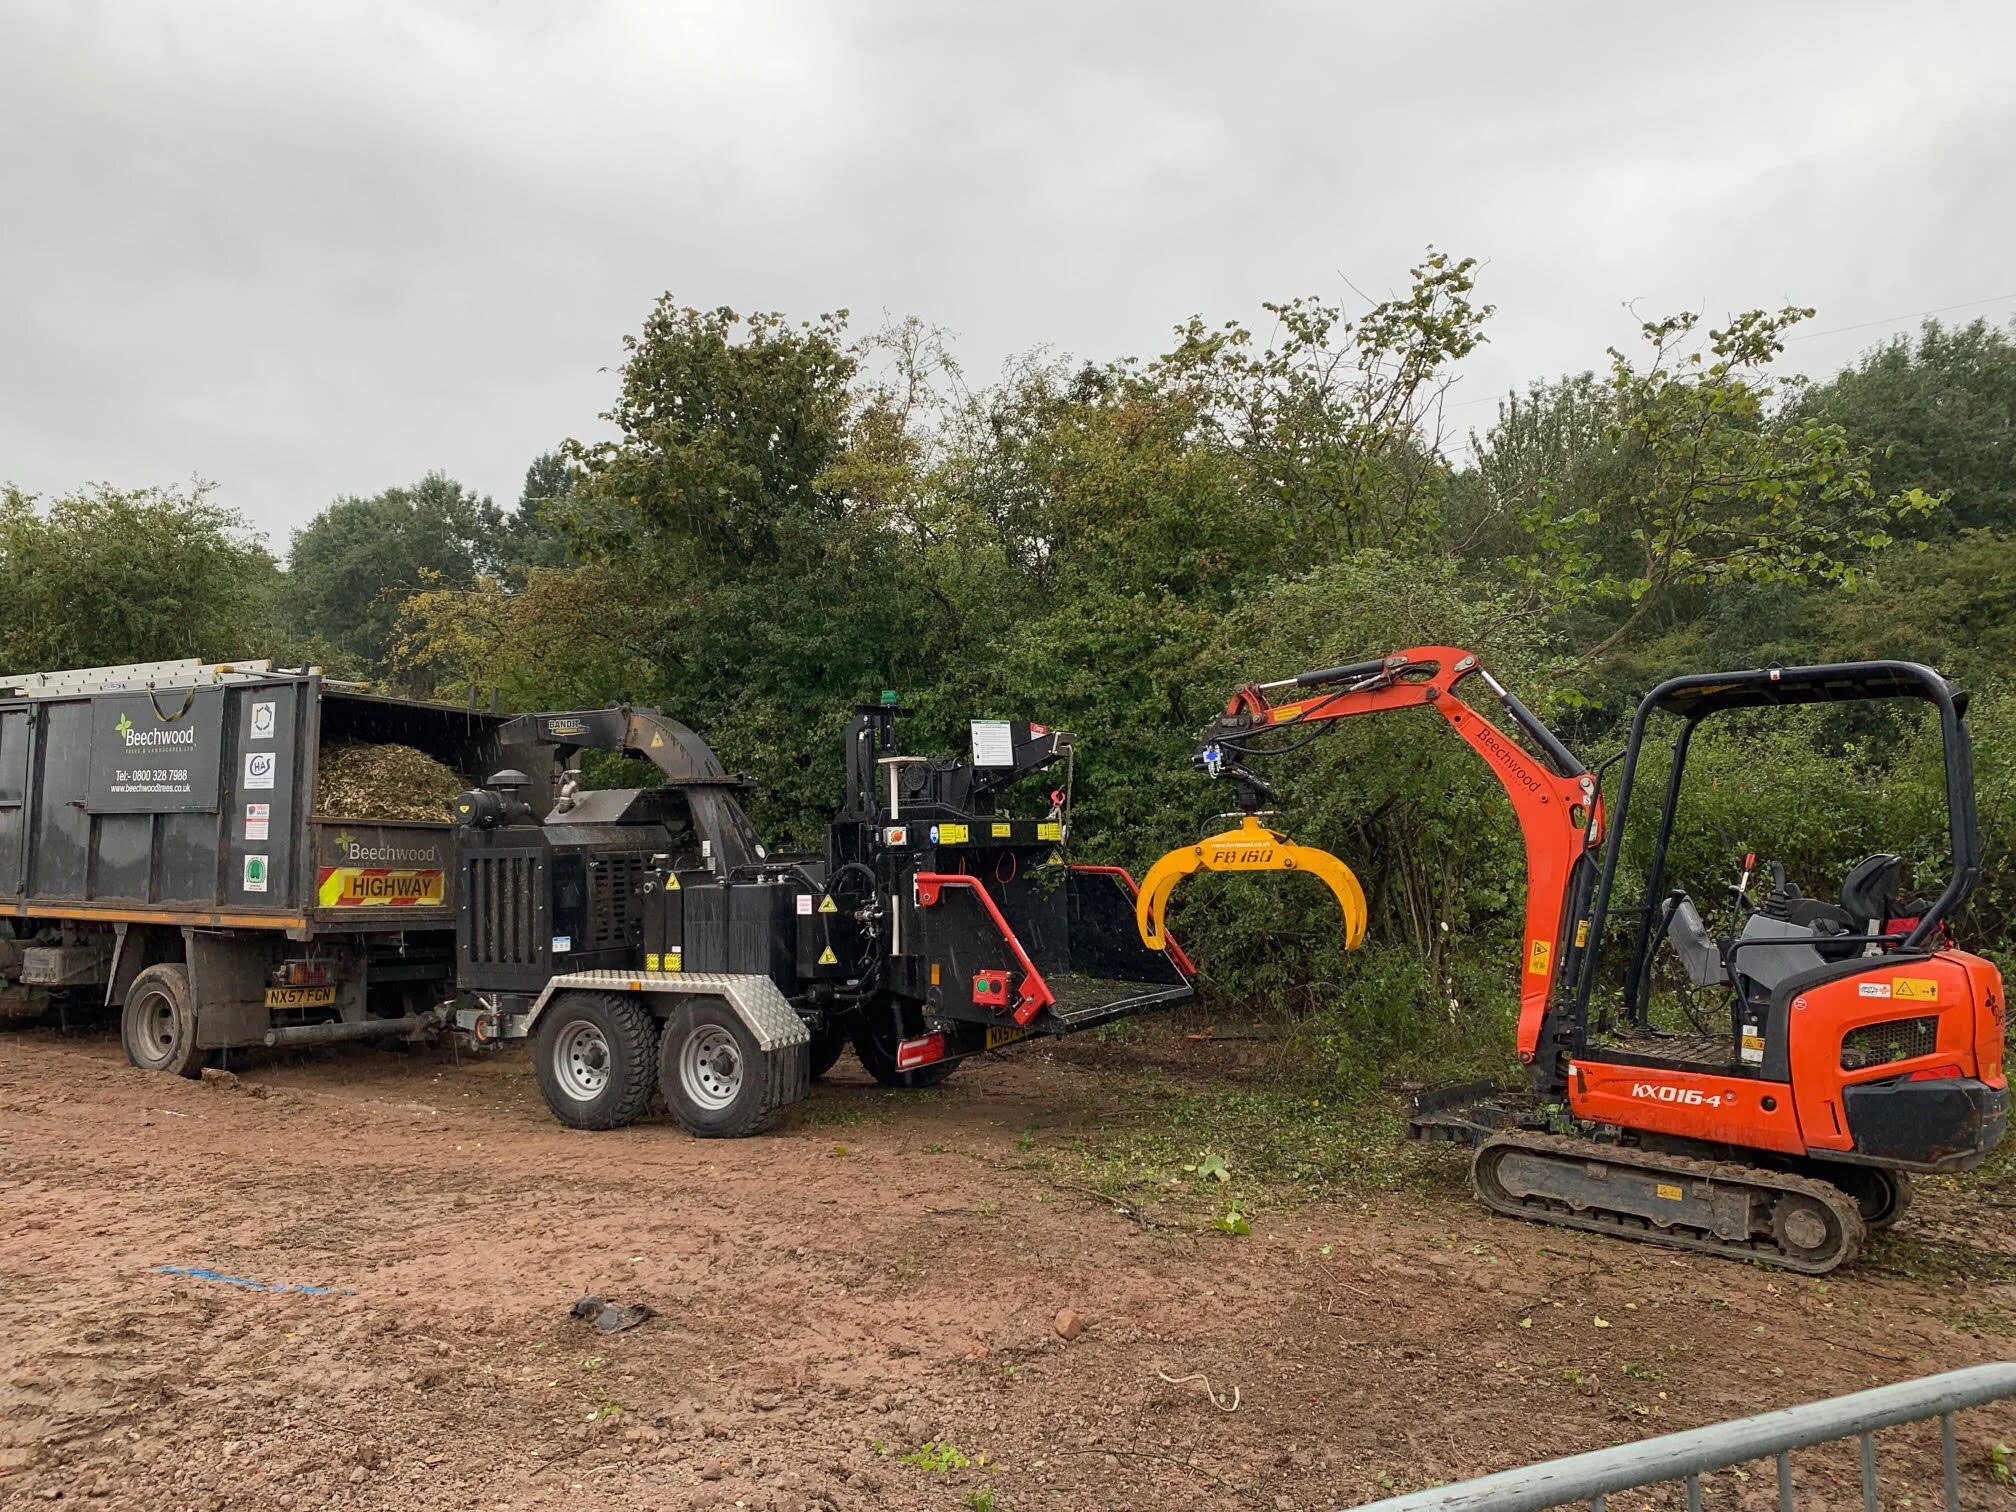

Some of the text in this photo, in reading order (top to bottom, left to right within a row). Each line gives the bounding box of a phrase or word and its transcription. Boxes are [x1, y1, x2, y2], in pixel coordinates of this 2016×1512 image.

[549, 719, 580, 729] BANDIT
[125, 725, 194, 747] Beechwood
[1477, 728, 1541, 792] Beechwood
[132, 769, 151, 781] 0800
[152, 769, 167, 781] 328
[169, 769, 188, 781] 7988
[110, 783, 191, 793] www.beechwoodtrees.co.uk
[349, 843, 435, 861] Beechwood
[1213, 849, 1274, 863] FB 160
[353, 877, 432, 896] HIGHWAY
[271, 987, 331, 1004] NX57 FGN
[1632, 1083, 1721, 1108] KX016-4
